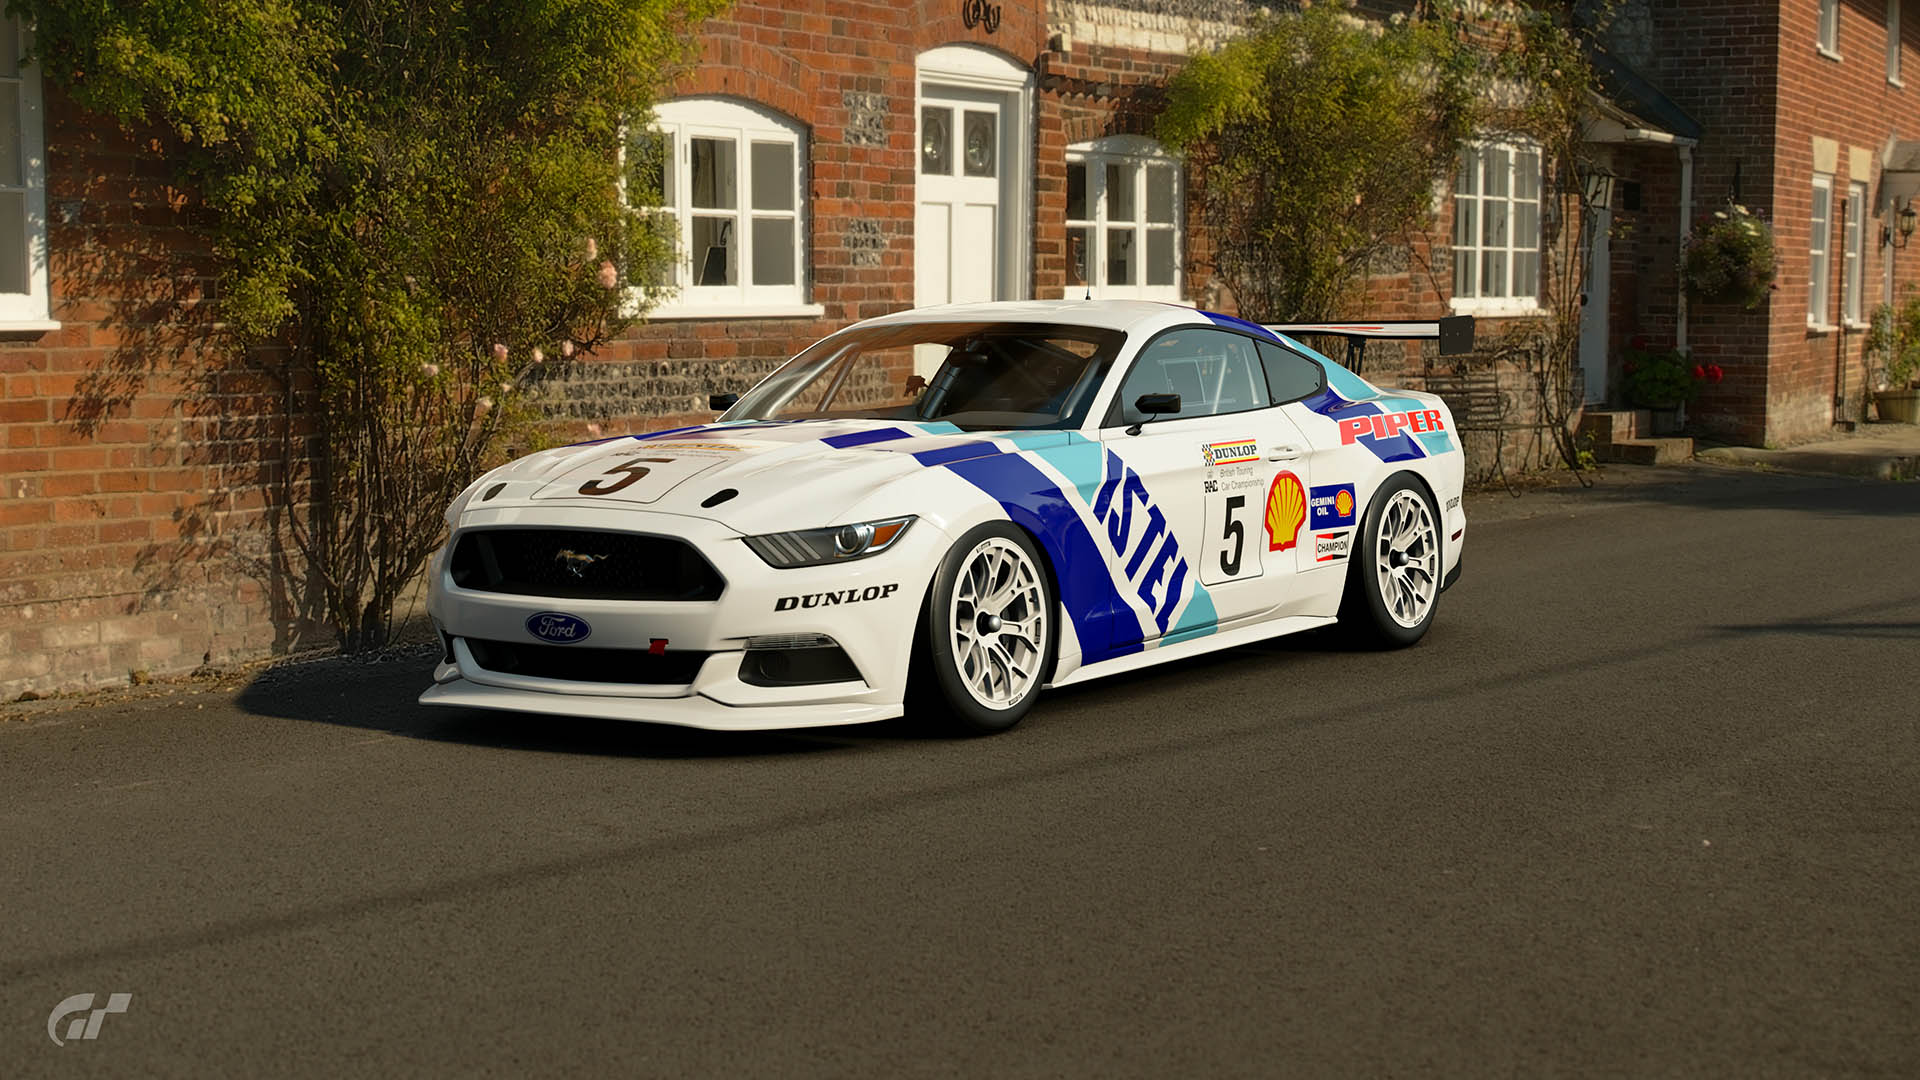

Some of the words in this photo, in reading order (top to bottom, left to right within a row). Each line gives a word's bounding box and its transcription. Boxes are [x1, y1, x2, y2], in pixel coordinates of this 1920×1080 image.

[1338, 409, 1445, 446] PIPER
[1213, 445, 1257, 459] DUNLOP
[578, 457, 677, 496] 5
[1204, 480, 1219, 493] RAC
[1311, 496, 1335, 507] GEMINI
[1316, 507, 1329, 516] OIL
[1220, 495, 1245, 576] 5
[1317, 541, 1348, 553] CHAMPION
[774, 583, 899, 612] DUNLOP
[538, 615, 577, 638] Ford
